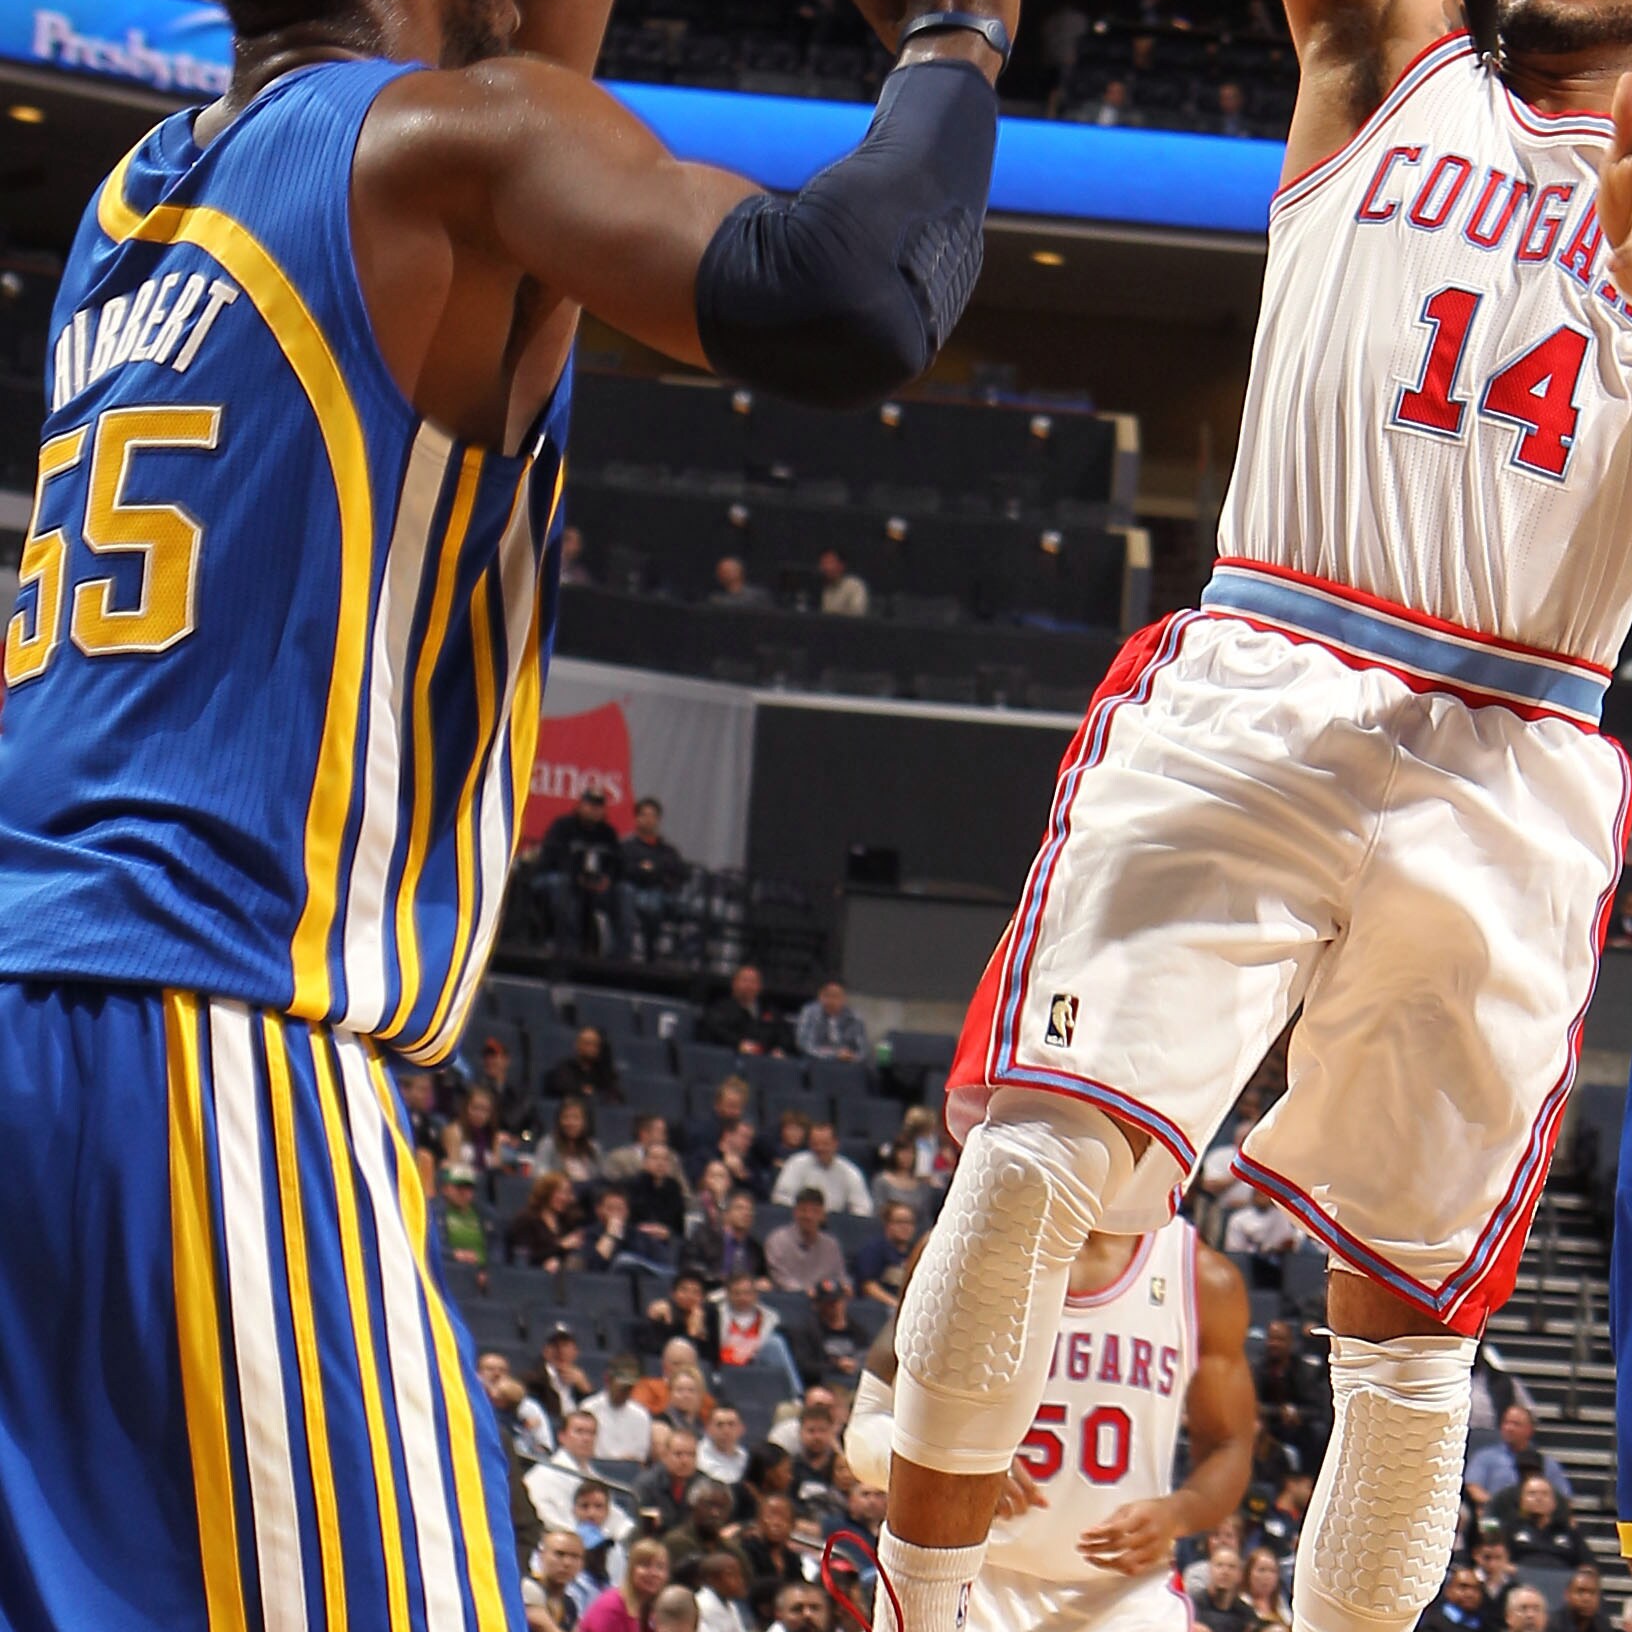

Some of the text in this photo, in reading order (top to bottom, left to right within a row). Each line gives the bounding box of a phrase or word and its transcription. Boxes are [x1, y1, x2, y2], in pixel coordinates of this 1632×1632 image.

[1386, 280, 1593, 485] 14
[4, 406, 222, 687] 55
[530, 760, 624, 806] anes
[1049, 1331, 1178, 1397] GARS
[1013, 1402, 1135, 1487] 50
